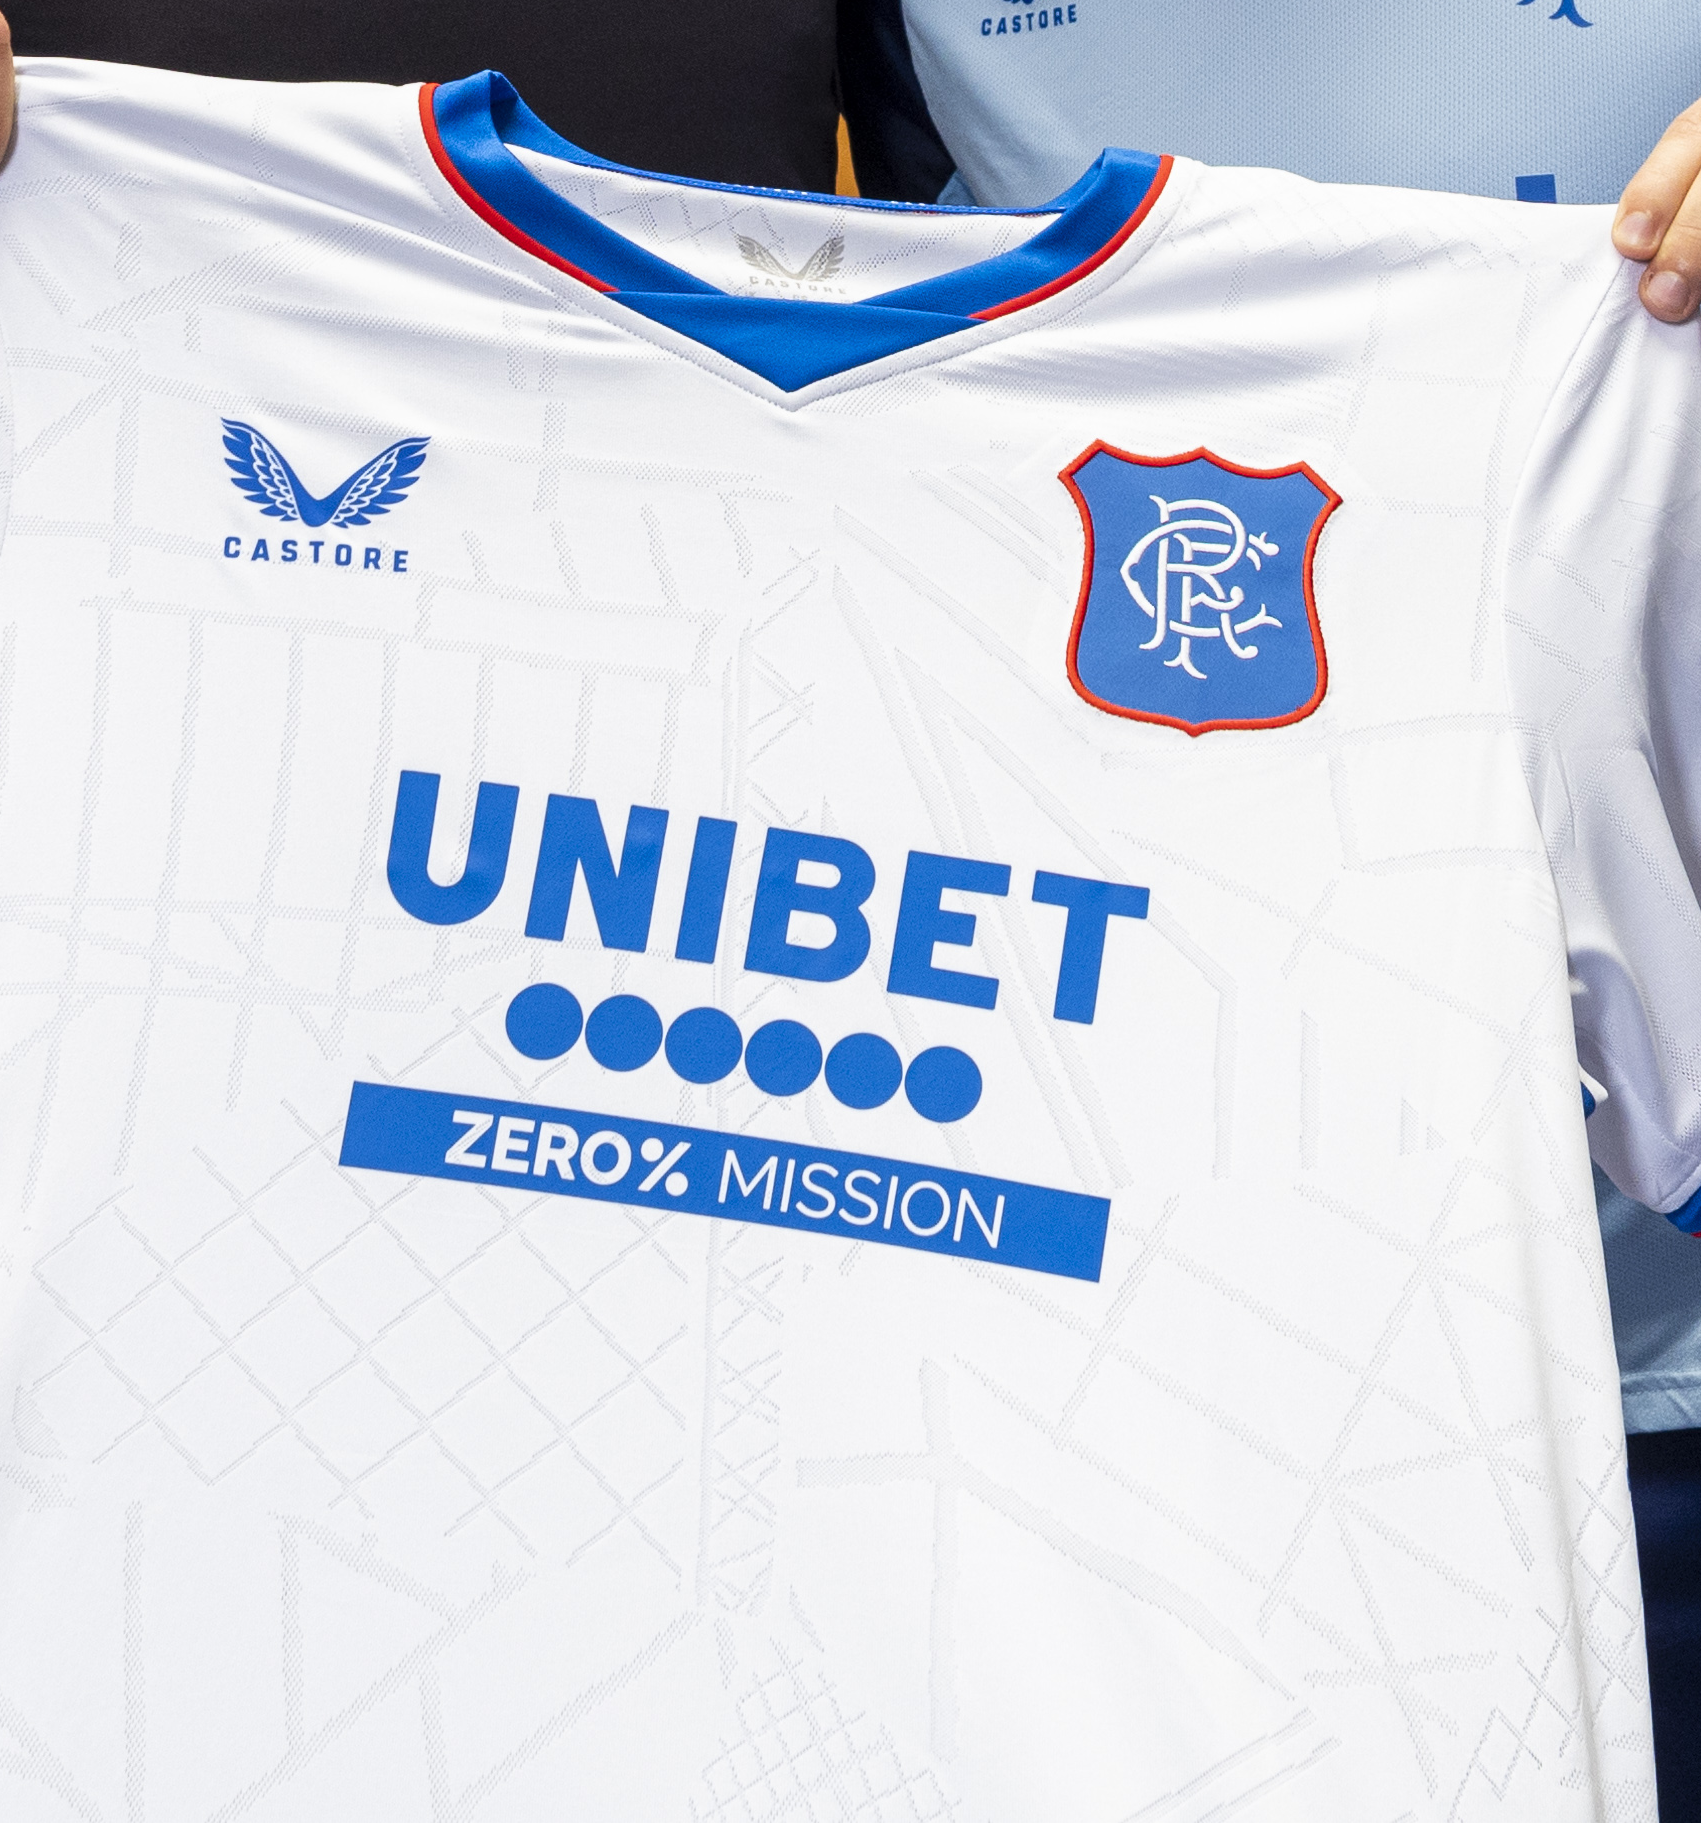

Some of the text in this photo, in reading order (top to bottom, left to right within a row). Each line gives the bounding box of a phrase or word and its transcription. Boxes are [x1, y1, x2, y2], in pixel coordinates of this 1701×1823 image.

[981, 3, 1077, 36] CASTORE
[749, 276, 847, 295] CASTORE
[224, 536, 408, 573] CASTORE
[386, 770, 1150, 1025] UNIBET
[445, 1109, 1005, 1249] ZERO% MISSION
